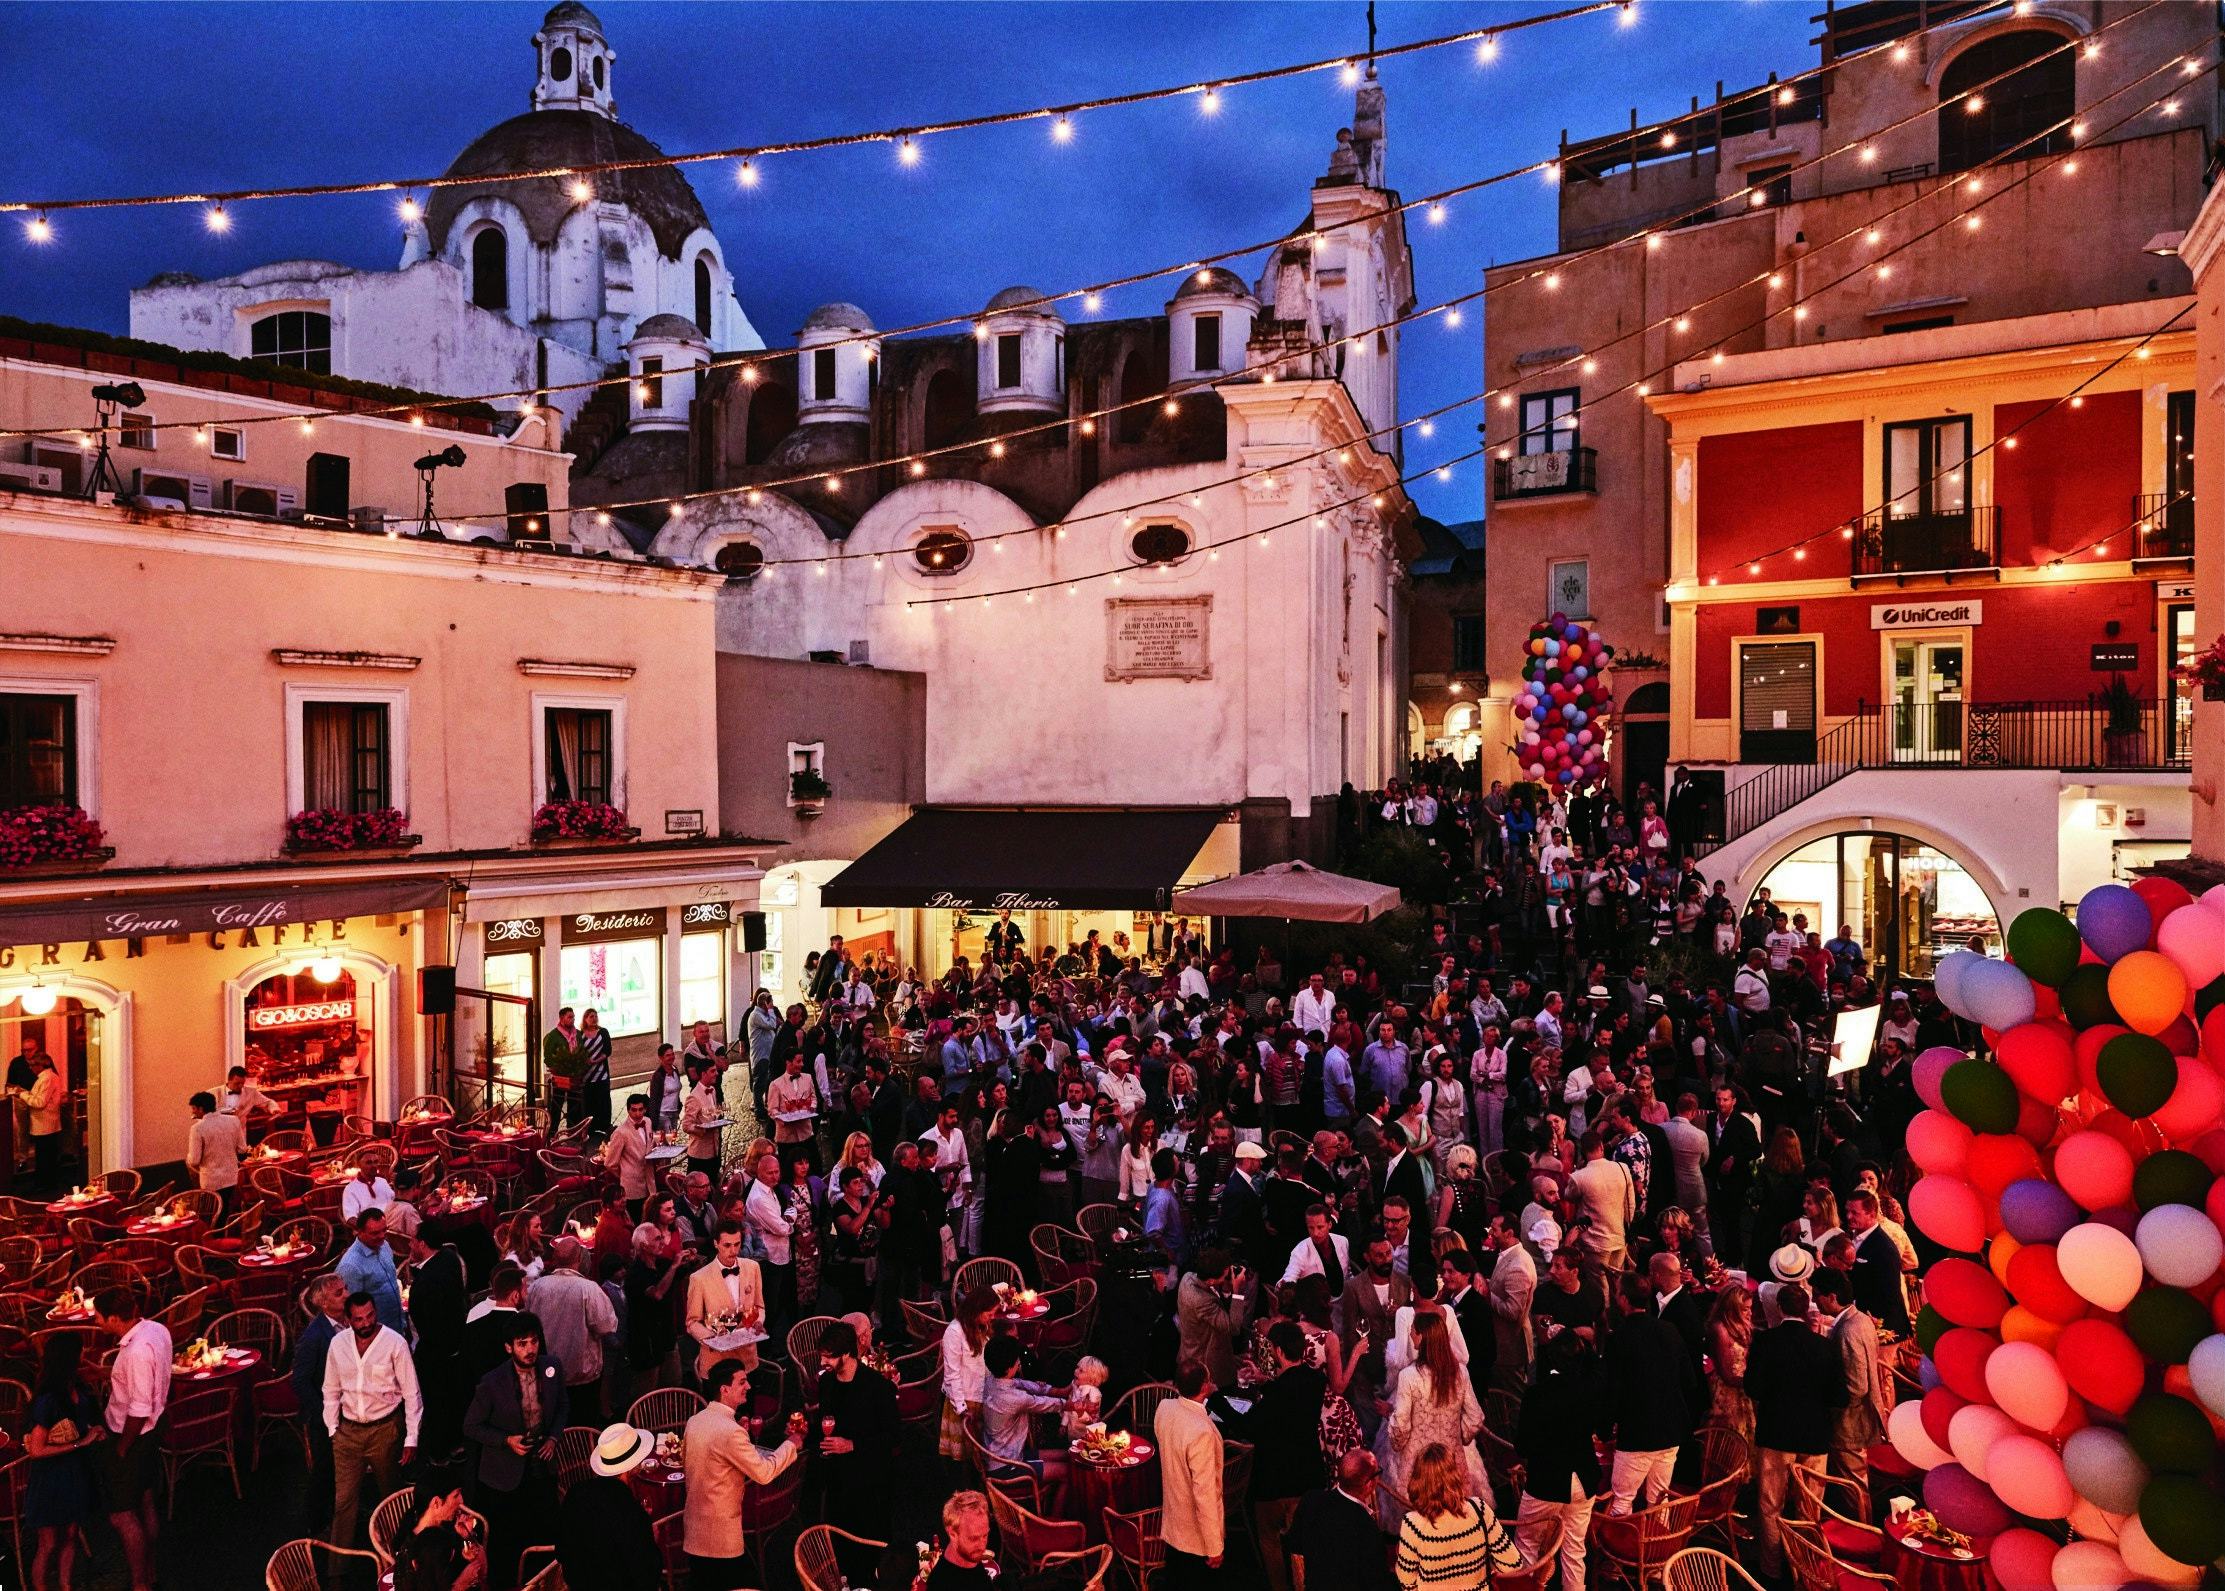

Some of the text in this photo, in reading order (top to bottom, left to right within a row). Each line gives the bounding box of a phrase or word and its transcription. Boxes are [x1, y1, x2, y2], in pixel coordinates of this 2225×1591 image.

[1901, 606, 1970, 623] UniCredit
[925, 891, 1060, 909] Bar Tiberio
[105, 912, 182, 934] Gran
[575, 912, 654, 934] Desiderio
[0, 936, 145, 969] GRAN
